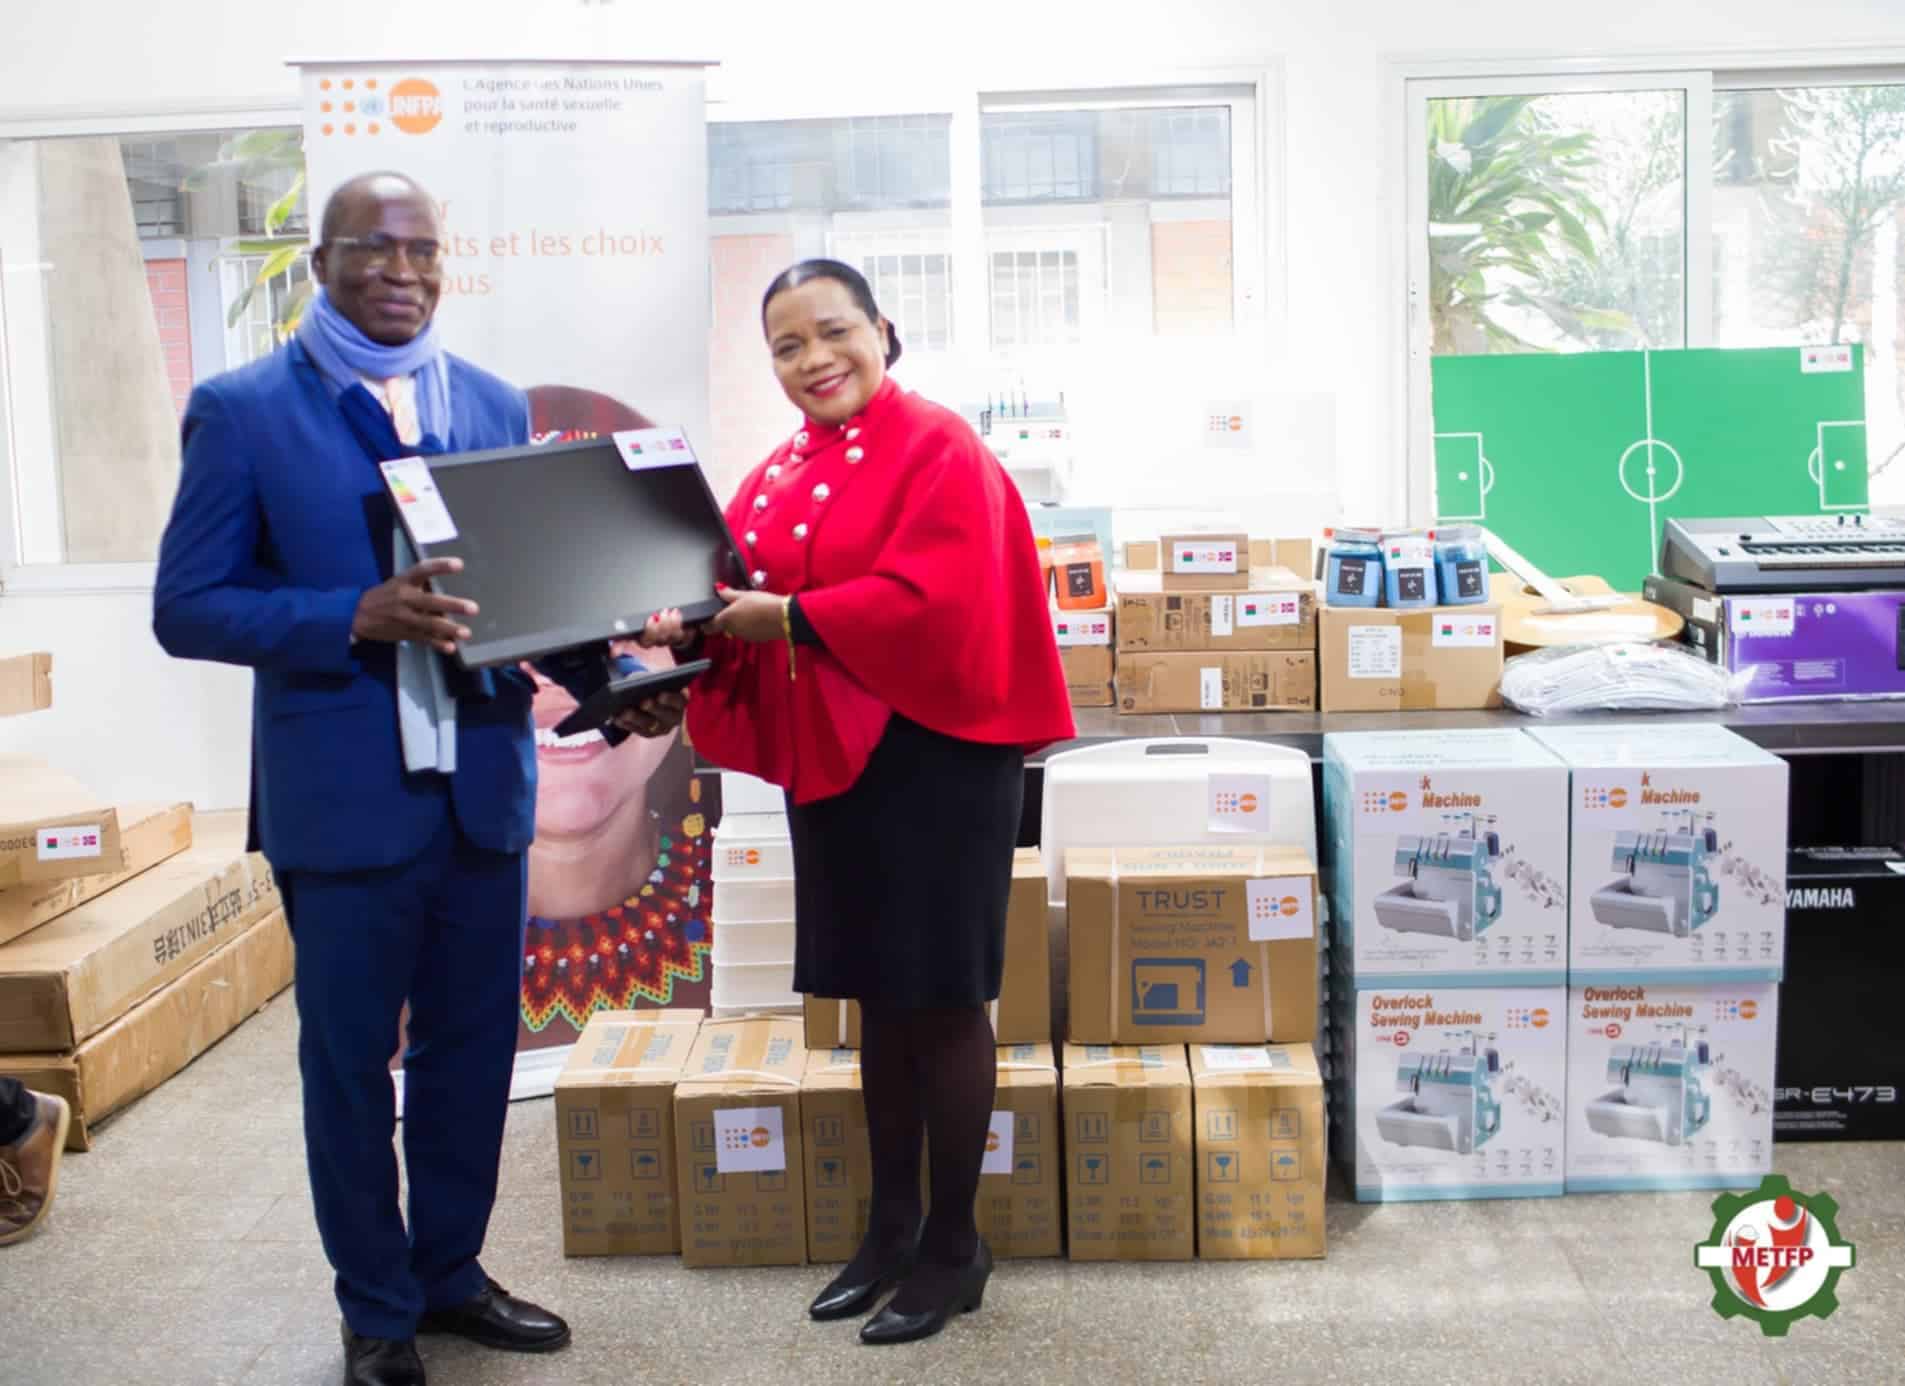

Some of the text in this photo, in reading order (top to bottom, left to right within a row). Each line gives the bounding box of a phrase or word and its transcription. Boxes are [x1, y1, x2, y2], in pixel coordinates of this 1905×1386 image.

[564, 77, 619, 90] Nations
[463, 96, 623, 112] pour la santé sexuelle
[465, 119, 577, 135] et reproductive
[489, 232, 521, 256] et
[529, 228, 573, 256] les
[581, 227, 664, 256] choix
[1422, 790, 1482, 808] Machine
[1641, 788, 1700, 804] Machine
[1136, 890, 1227, 911] TRUST
[1786, 887, 1855, 908] YAMAHA
[1583, 985, 1645, 1000] Overlock
[1372, 994, 1433, 1009] Overlock
[1370, 1010, 1482, 1029] Sewing Machine
[1582, 1001, 1693, 1021] Sewing Machine
